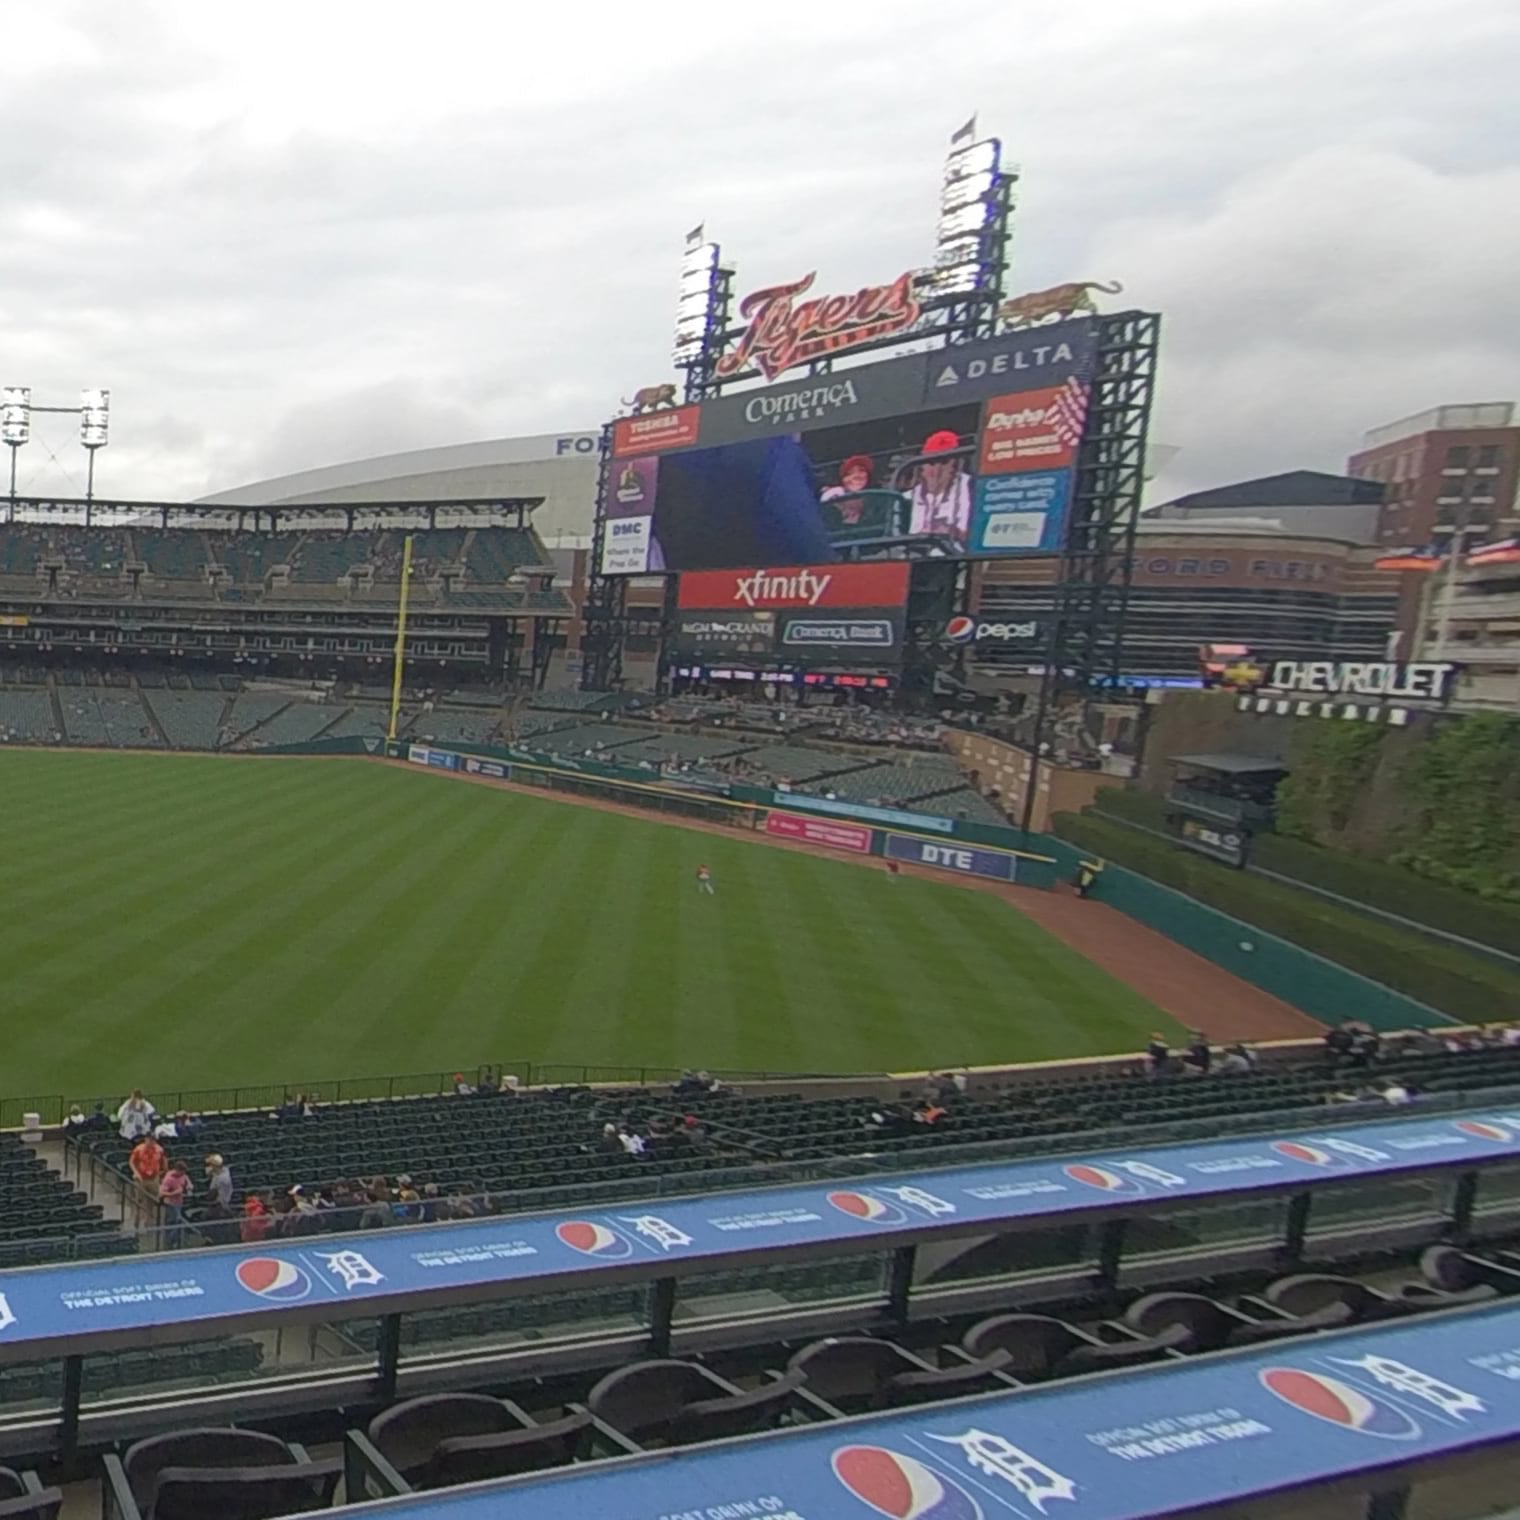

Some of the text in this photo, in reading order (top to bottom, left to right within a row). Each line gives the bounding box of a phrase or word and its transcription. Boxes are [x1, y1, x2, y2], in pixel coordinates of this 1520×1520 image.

[714, 270, 920, 382] Tigers
[967, 343, 1073, 378] DELTA
[772, 407, 825, 424] PARK
[612, 522, 643, 535] DMC
[734, 569, 832, 606] xfinity
[976, 621, 1037, 640] pepsi
[1271, 661, 1454, 697] CHEVROLET
[920, 844, 973, 870] DTE
